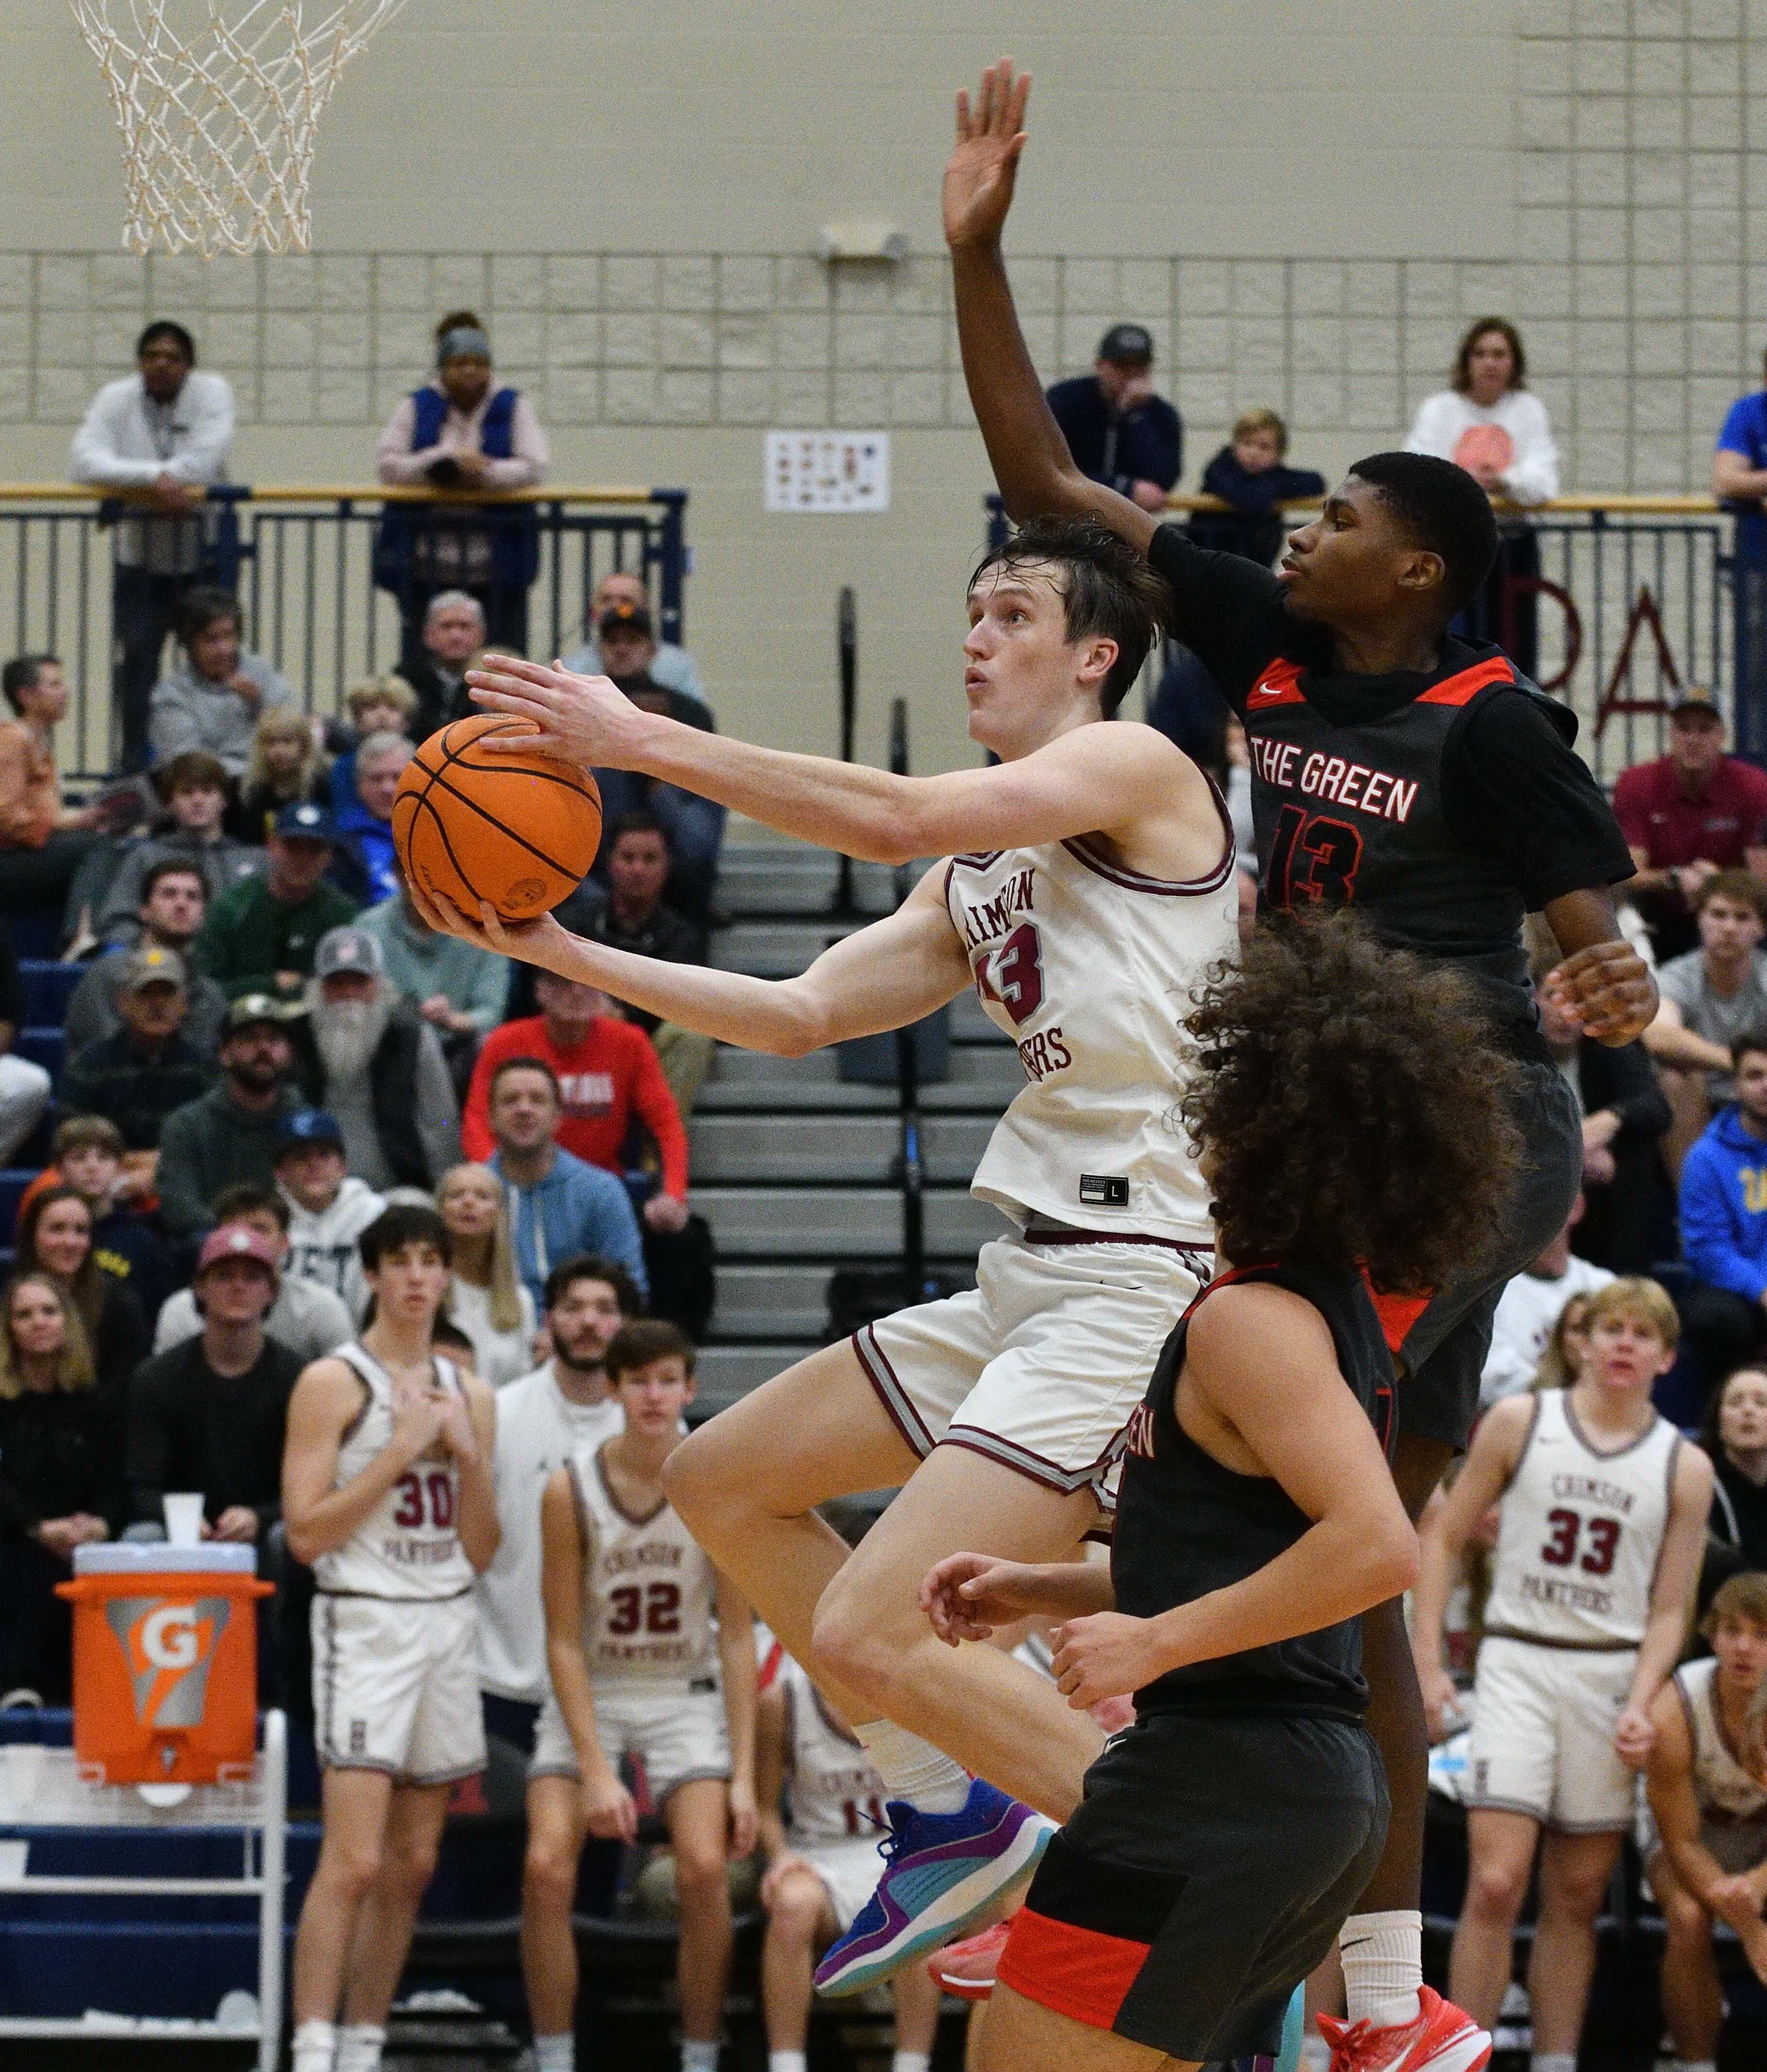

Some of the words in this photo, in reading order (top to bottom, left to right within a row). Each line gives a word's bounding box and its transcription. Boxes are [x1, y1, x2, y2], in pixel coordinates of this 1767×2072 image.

[1249, 734, 1302, 789] THE
[1299, 751, 1419, 824] GREEN
[1266, 804, 1364, 927] 13
[1112, 1185, 1118, 1197] L
[395, 1473, 451, 1528] 30
[1542, 1508, 1620, 1576] 33
[143, 1607, 198, 1669] G
[610, 1582, 680, 1634] 32
